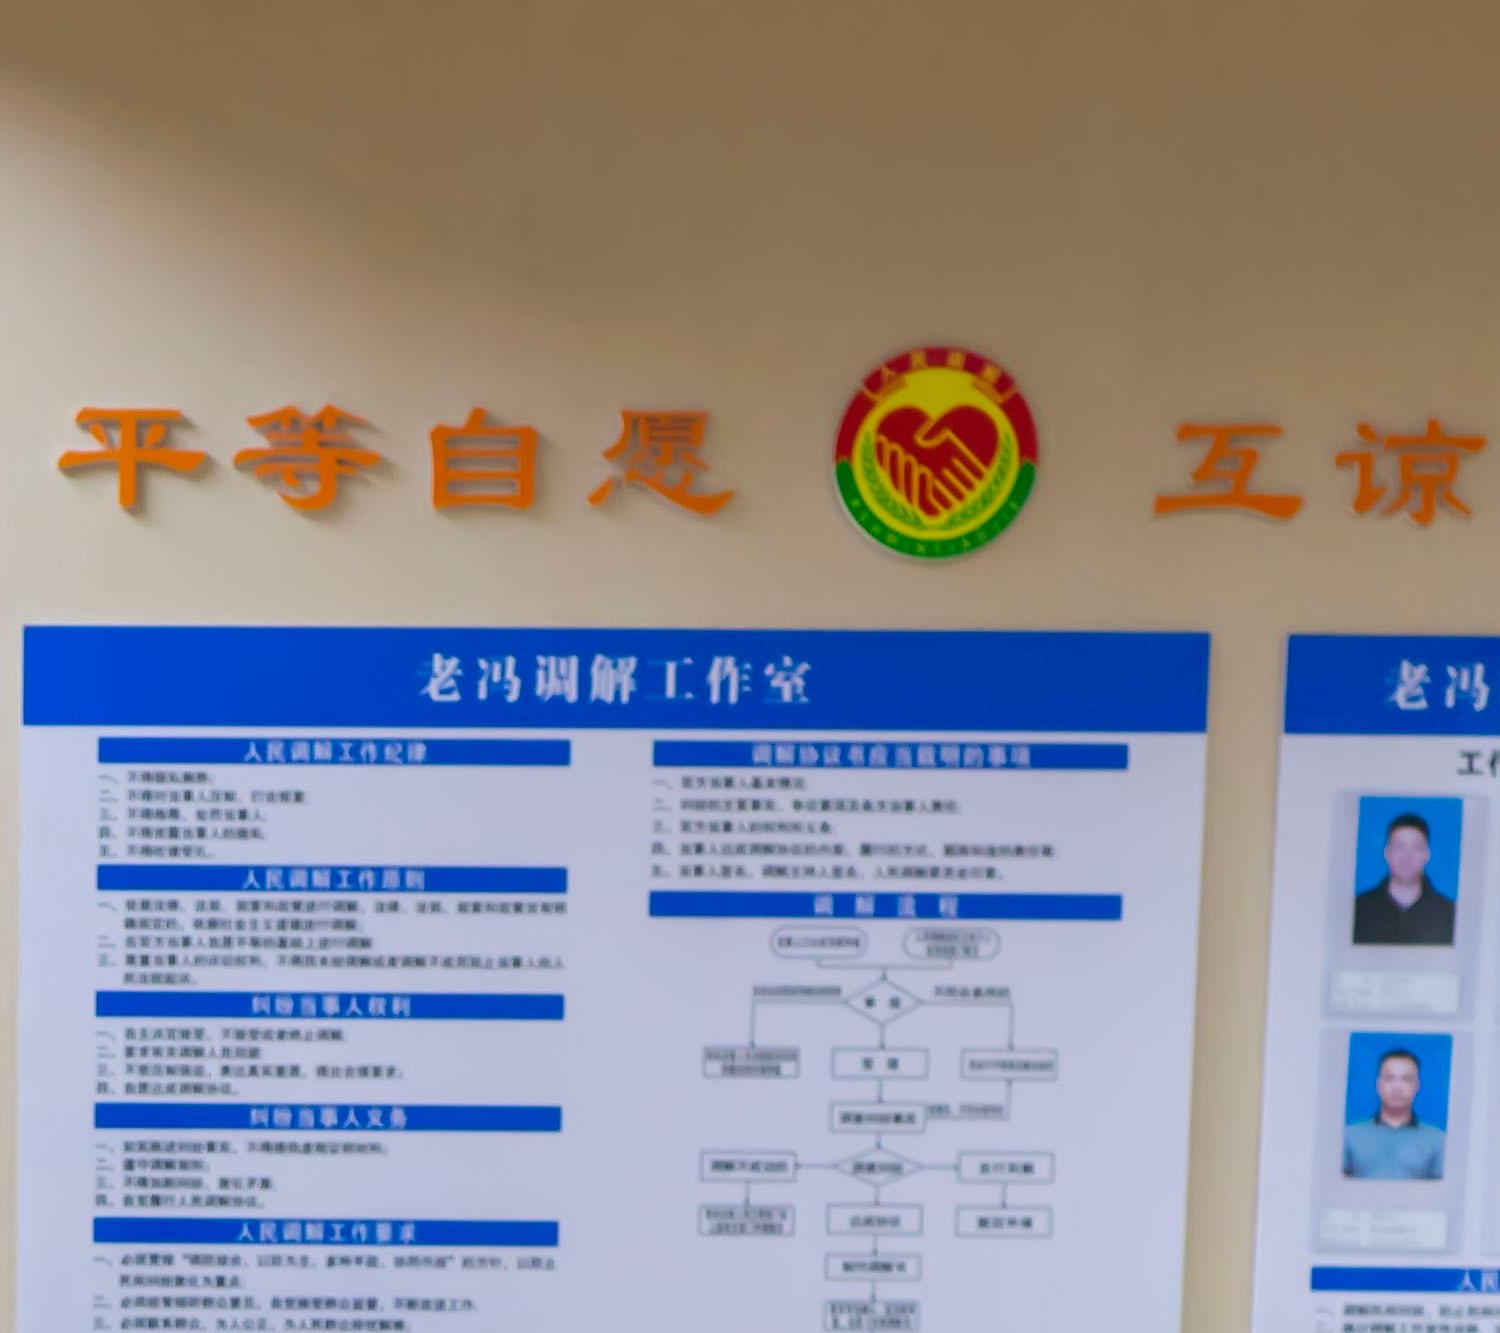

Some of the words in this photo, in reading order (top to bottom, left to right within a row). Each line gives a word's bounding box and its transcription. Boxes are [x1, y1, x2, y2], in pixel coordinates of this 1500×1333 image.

[58, 403, 738, 517] 平等自愿
[420, 652, 812, 705] 老冯调解工作室
[243, 740, 428, 764] 人民调解工作纪律
